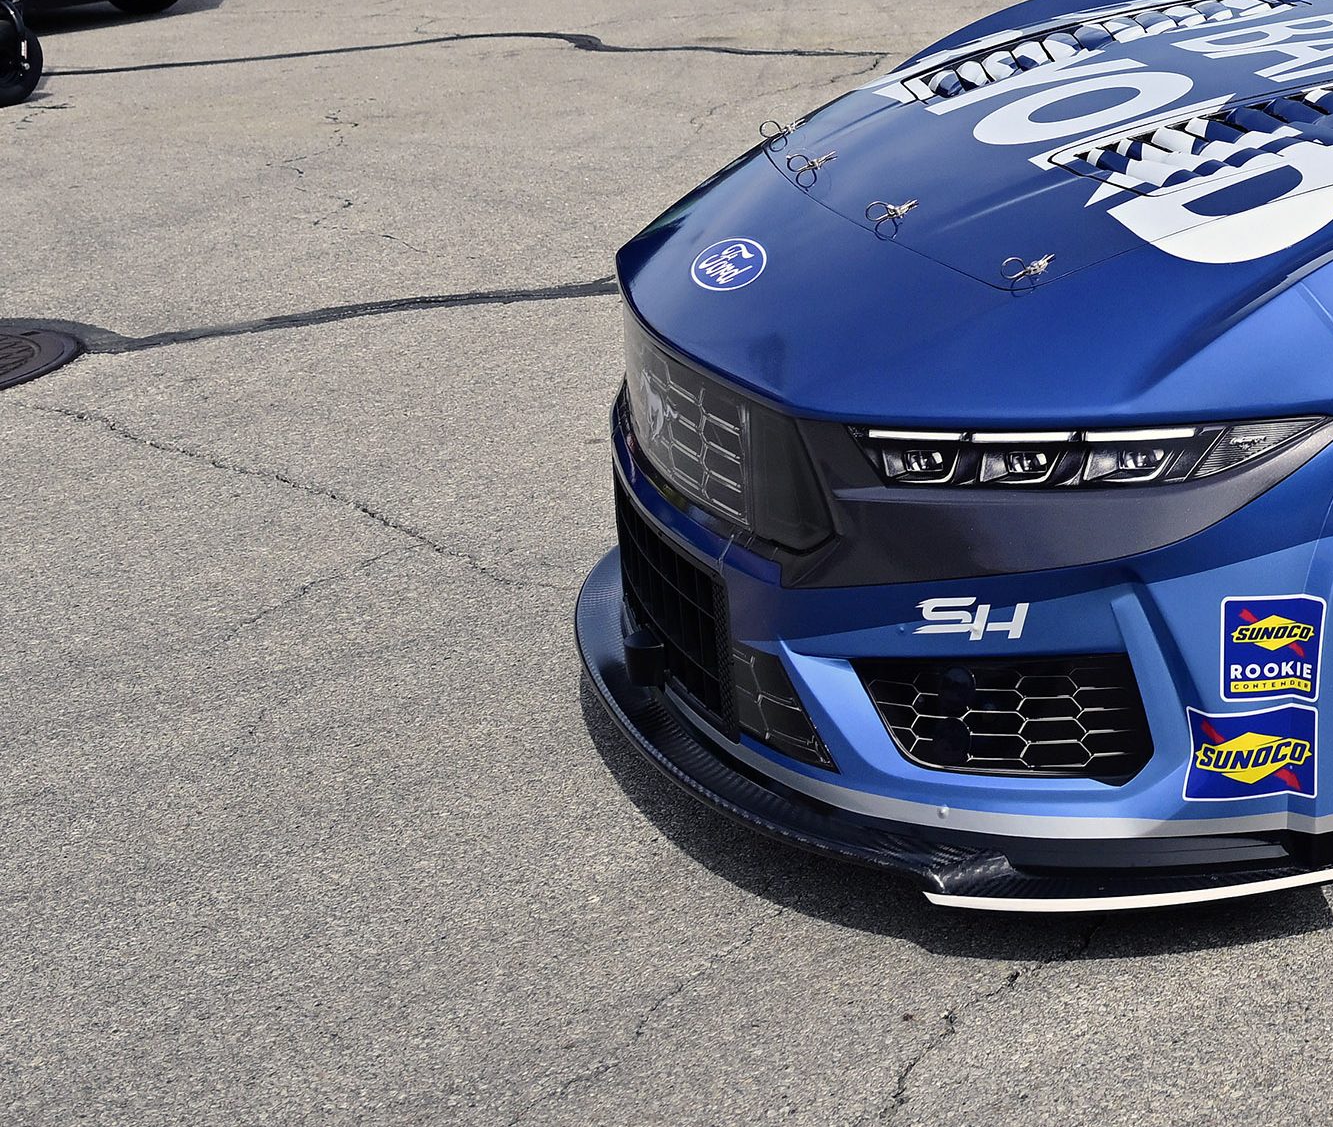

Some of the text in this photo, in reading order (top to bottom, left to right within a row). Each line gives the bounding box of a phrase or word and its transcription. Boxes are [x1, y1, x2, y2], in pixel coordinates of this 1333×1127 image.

[698, 243, 755, 285] Ford
[1235, 624, 1312, 641] SUNOCO
[1230, 660, 1313, 679] ROOKIE
[1233, 679, 1309, 690] CONTENDER
[1201, 740, 1306, 771] SUNOCO
